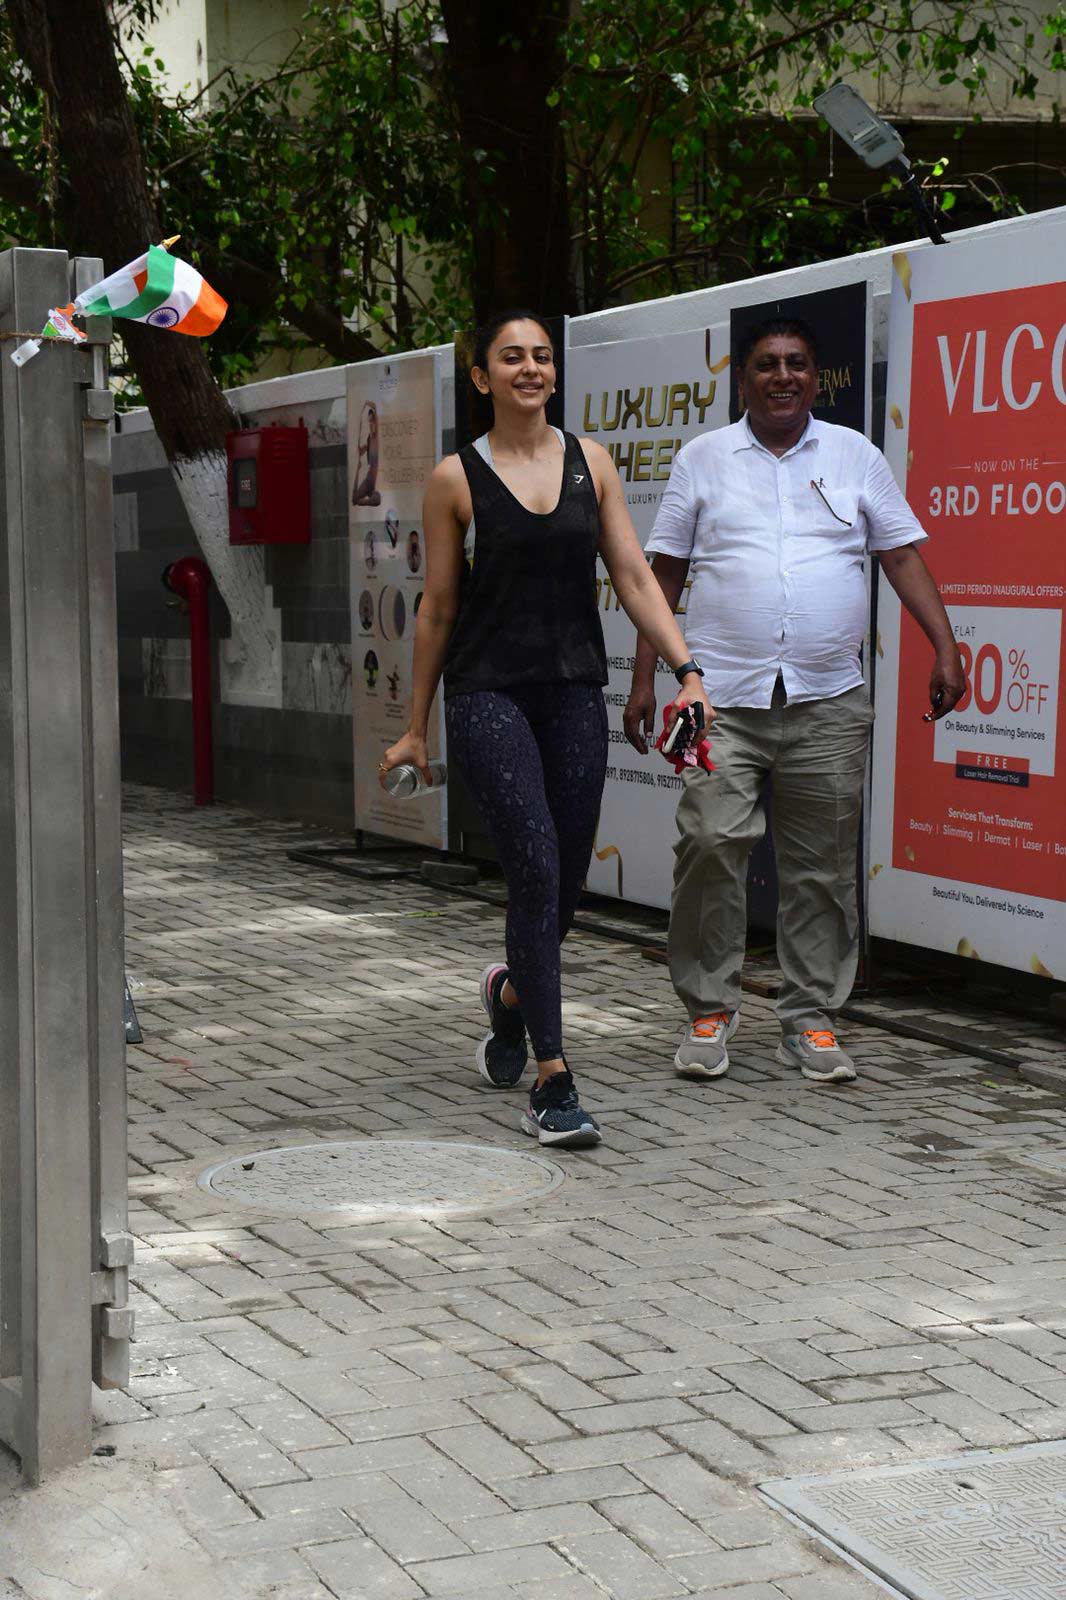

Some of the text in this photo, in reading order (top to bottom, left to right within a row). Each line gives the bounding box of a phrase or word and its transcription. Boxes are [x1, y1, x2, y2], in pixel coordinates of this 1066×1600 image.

[583, 380, 716, 432] LUXURY
[974, 458, 1039, 473] NOW ON THE
[627, 493, 657, 505] LUXURY
[929, 485, 980, 517] 3RD
[940, 584, 1064, 597] LIMITED PERIOD INAUGURAL OFFERS
[954, 625, 976, 637] FLAT
[1007, 682, 1049, 715] OFF
[945, 719, 1046, 741] On Beauty & Slimming Services
[977, 755, 1008, 769] FREE
[948, 807, 1034, 830] Services That Transform:
[909, 819, 933, 835] Beauty
[943, 824, 974, 842] Slimming
[1022, 838, 1043, 851] Laser
[932, 886, 961, 900] Beautiful
[976, 895, 1007, 911] Delivered
[1007, 902, 1016, 916] by
[1017, 904, 1045, 919] Science
